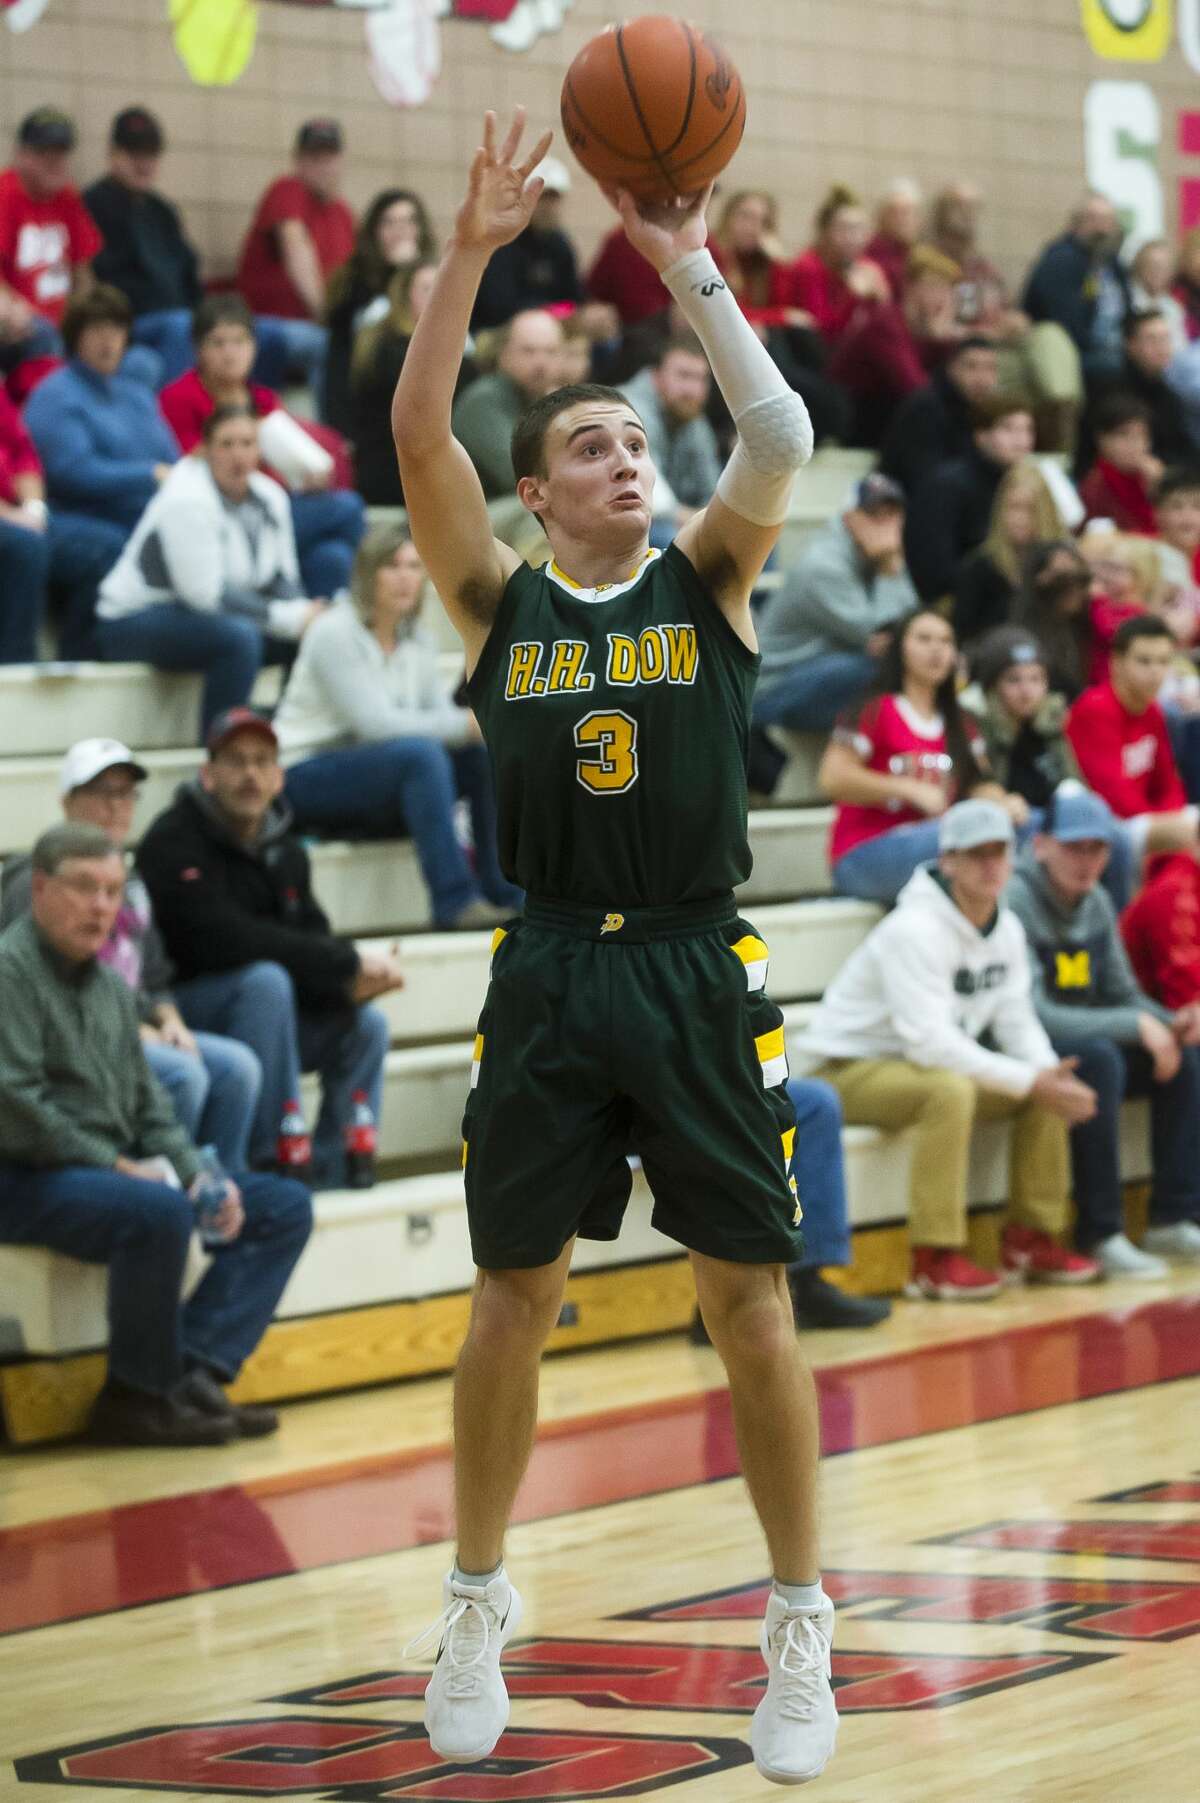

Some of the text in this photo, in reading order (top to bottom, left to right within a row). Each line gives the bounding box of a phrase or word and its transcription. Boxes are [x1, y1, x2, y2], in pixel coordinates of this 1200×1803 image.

[505, 624, 698, 701] H.H. DOW
[573, 708, 639, 796] 3
[1055, 950, 1091, 989] M
